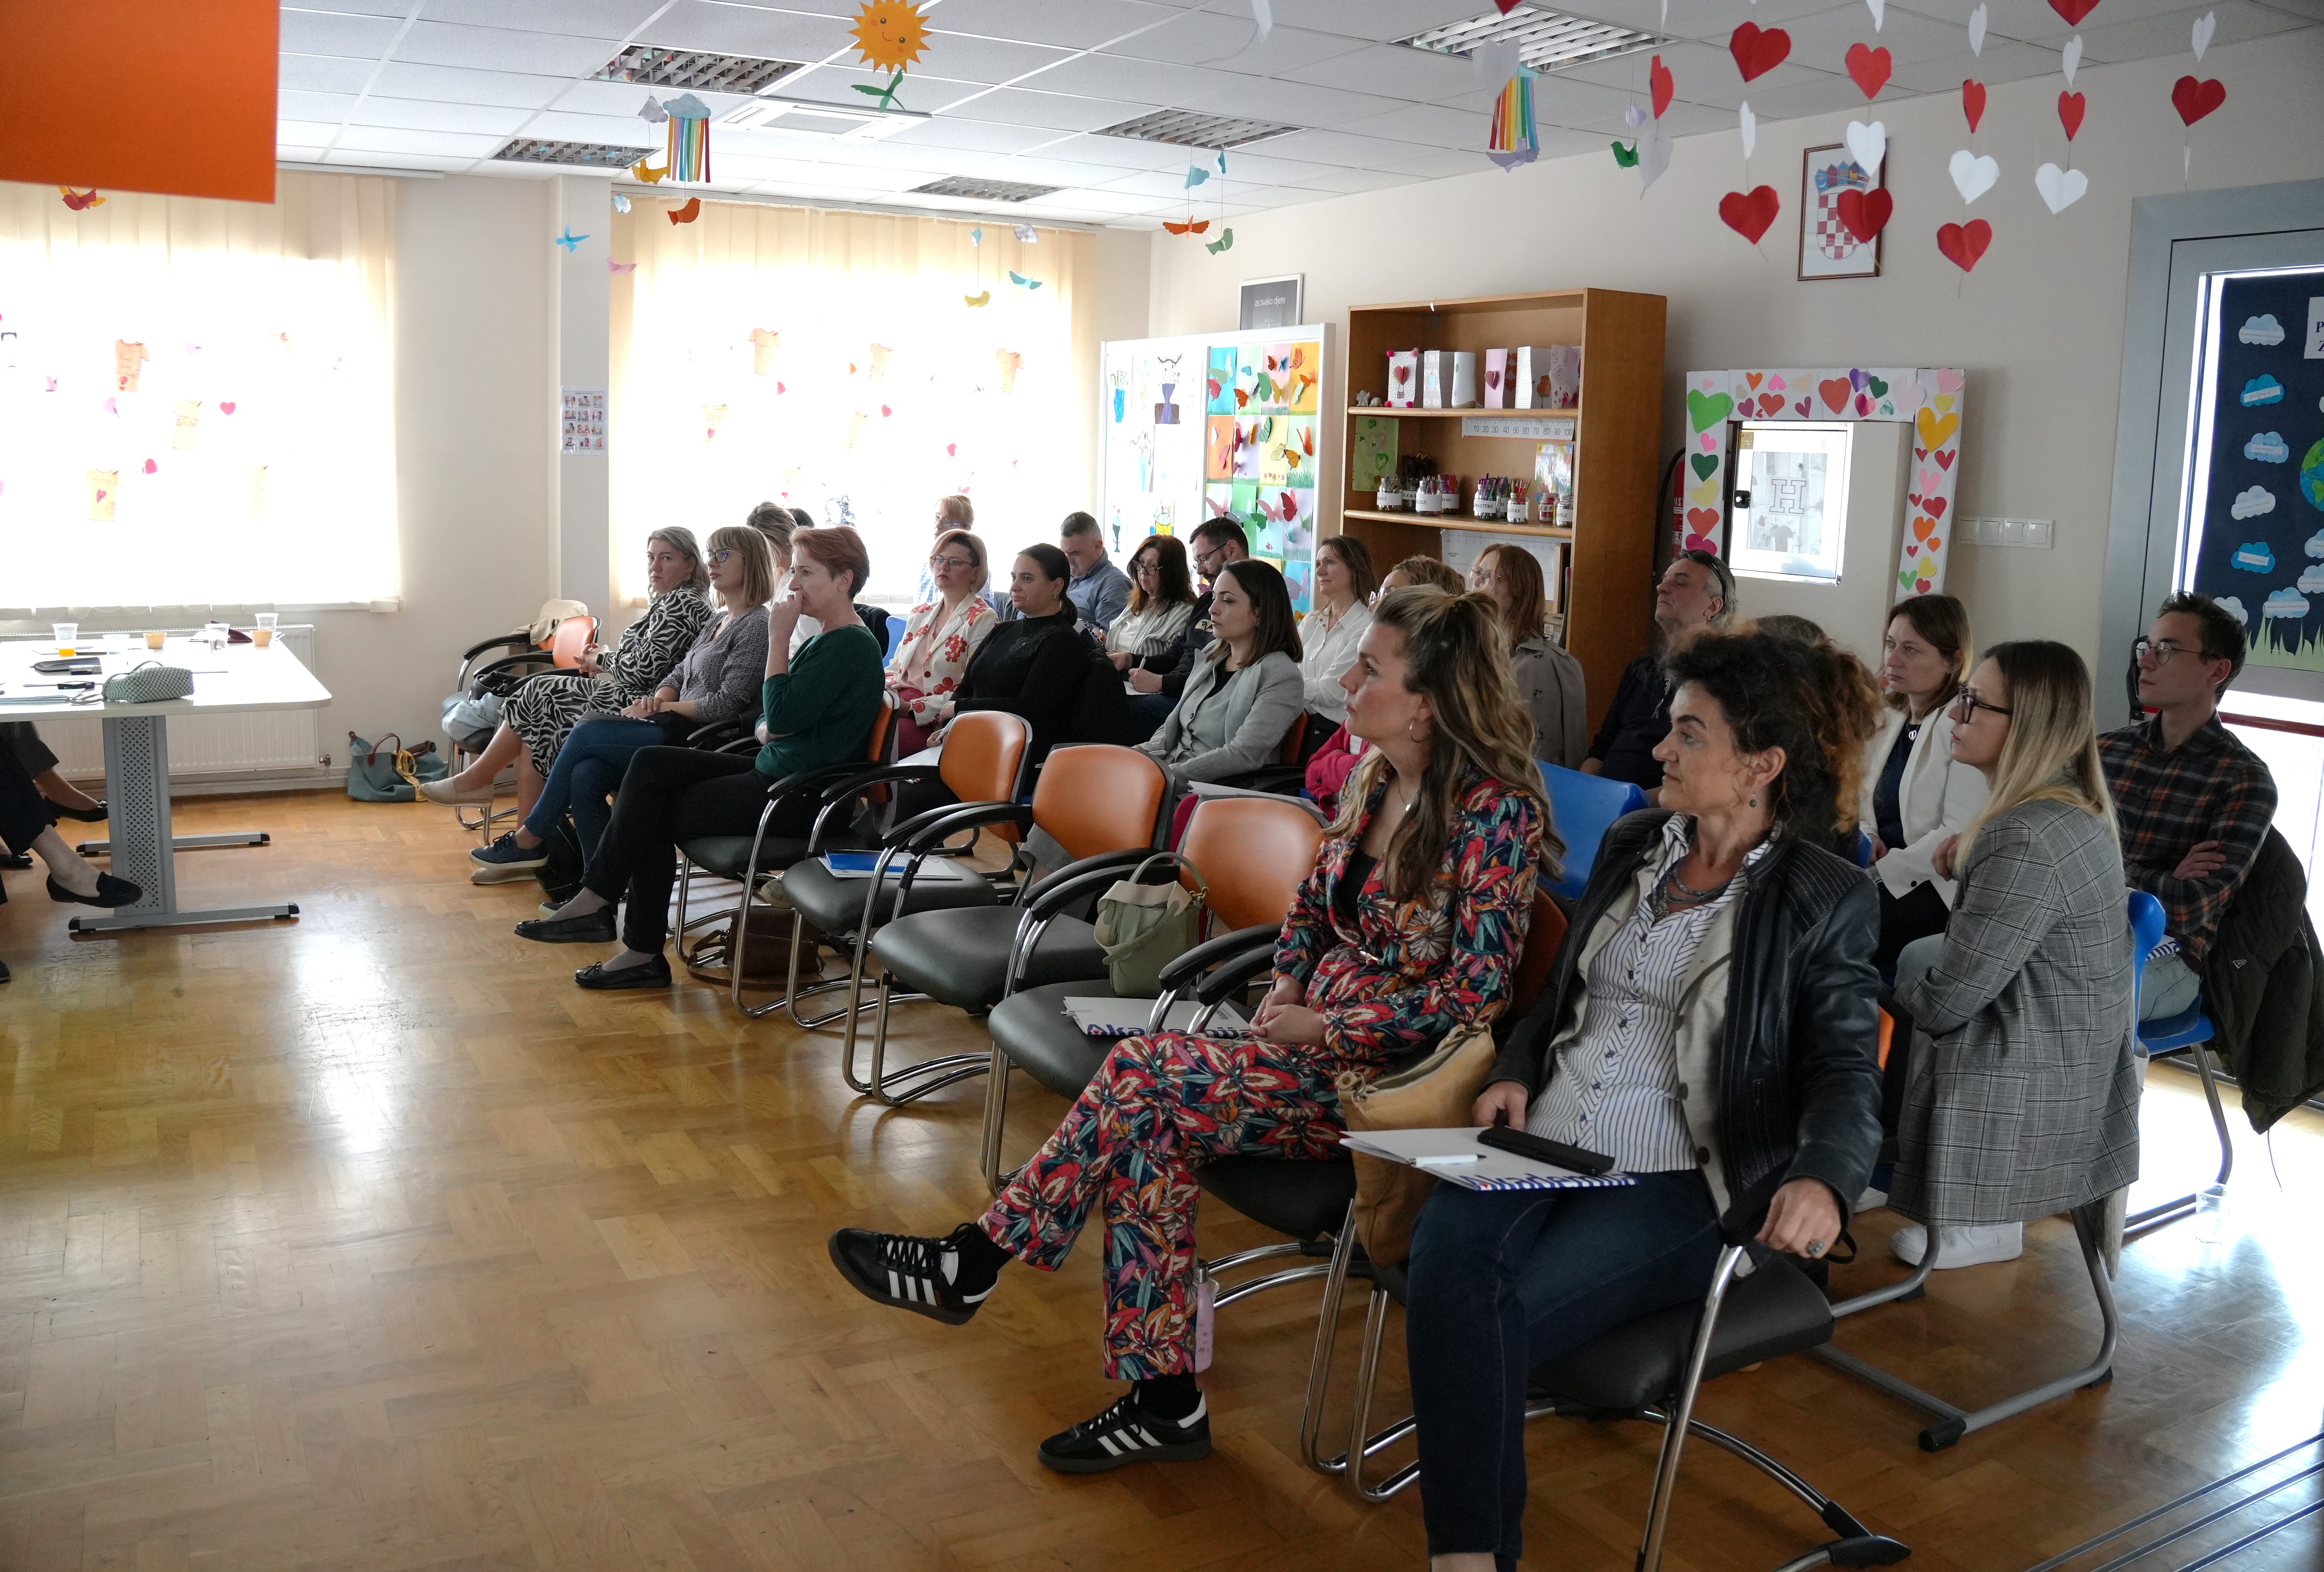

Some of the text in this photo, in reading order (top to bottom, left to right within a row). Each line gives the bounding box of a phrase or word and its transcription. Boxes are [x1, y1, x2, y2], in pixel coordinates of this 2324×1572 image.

[1260, 297, 1273, 306] svako
[1273, 296, 1286, 306] dijete
[1769, 479, 1806, 514] H
